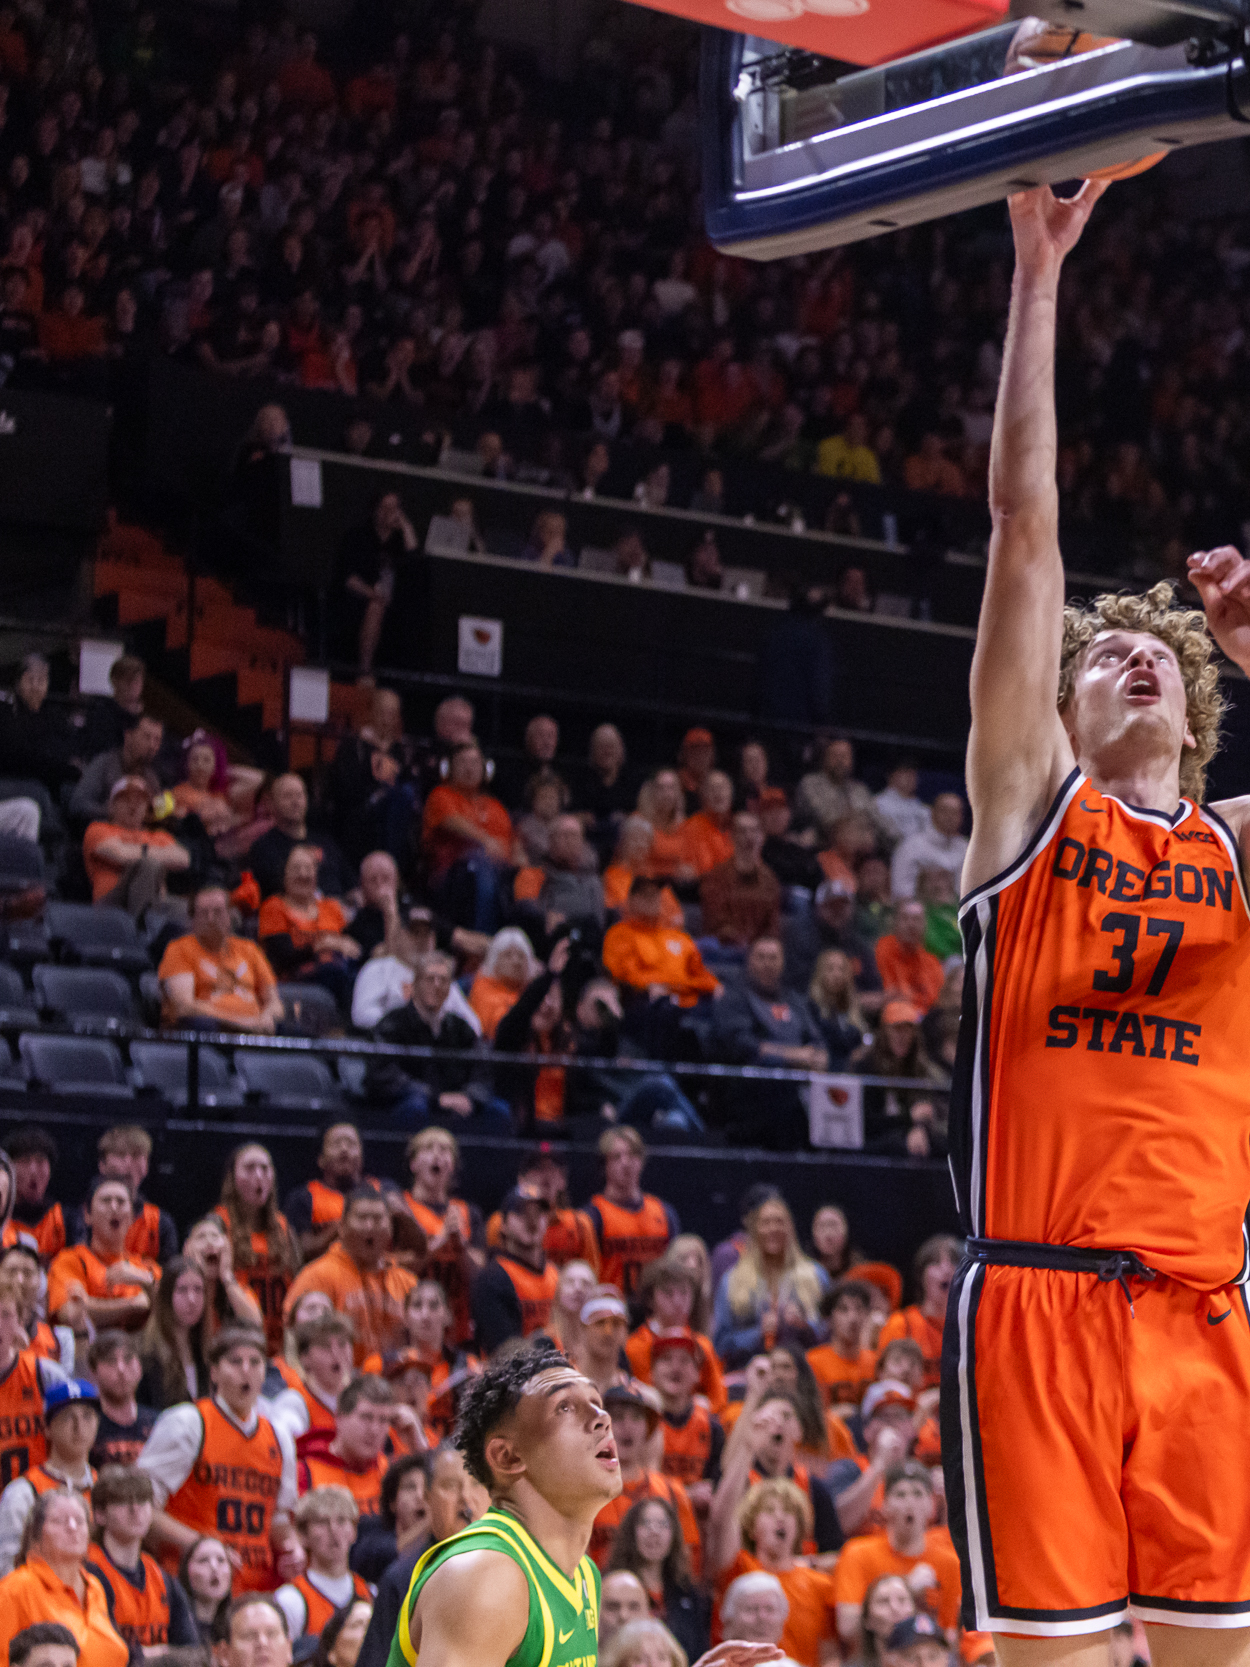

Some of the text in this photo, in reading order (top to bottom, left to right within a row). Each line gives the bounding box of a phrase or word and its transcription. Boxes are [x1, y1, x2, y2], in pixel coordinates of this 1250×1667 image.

[1172, 830, 1217, 844] WCC
[1052, 838, 1234, 912] OREGON
[1092, 912, 1185, 997] 37
[1045, 1005, 1202, 1067] STATE
[217, 1498, 265, 1536] 00
